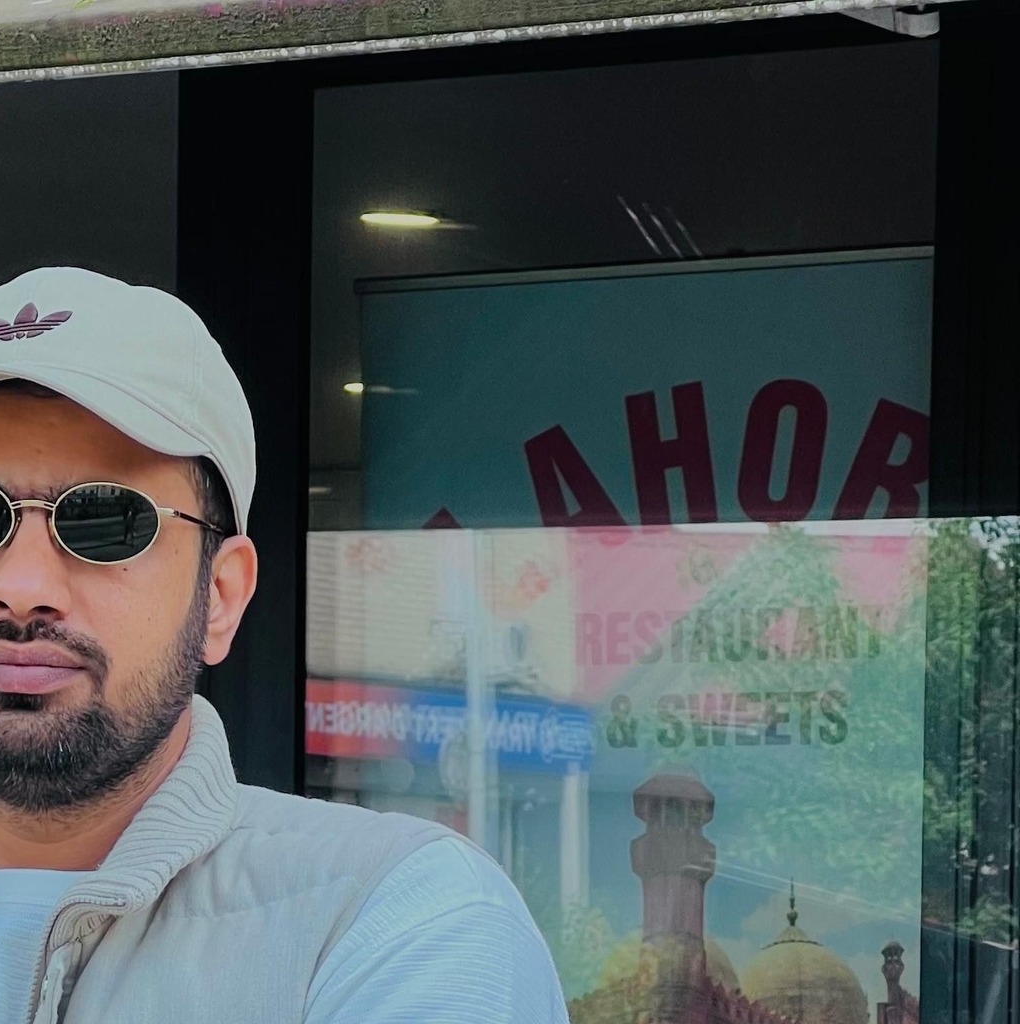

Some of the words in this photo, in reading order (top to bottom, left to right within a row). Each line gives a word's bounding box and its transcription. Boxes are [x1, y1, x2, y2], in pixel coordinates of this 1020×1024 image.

[423, 378, 930, 532] AHOR
[575, 608, 883, 666] RESTAURANT
[606, 694, 639, 749] &
[656, 689, 849, 748] SWEETS
